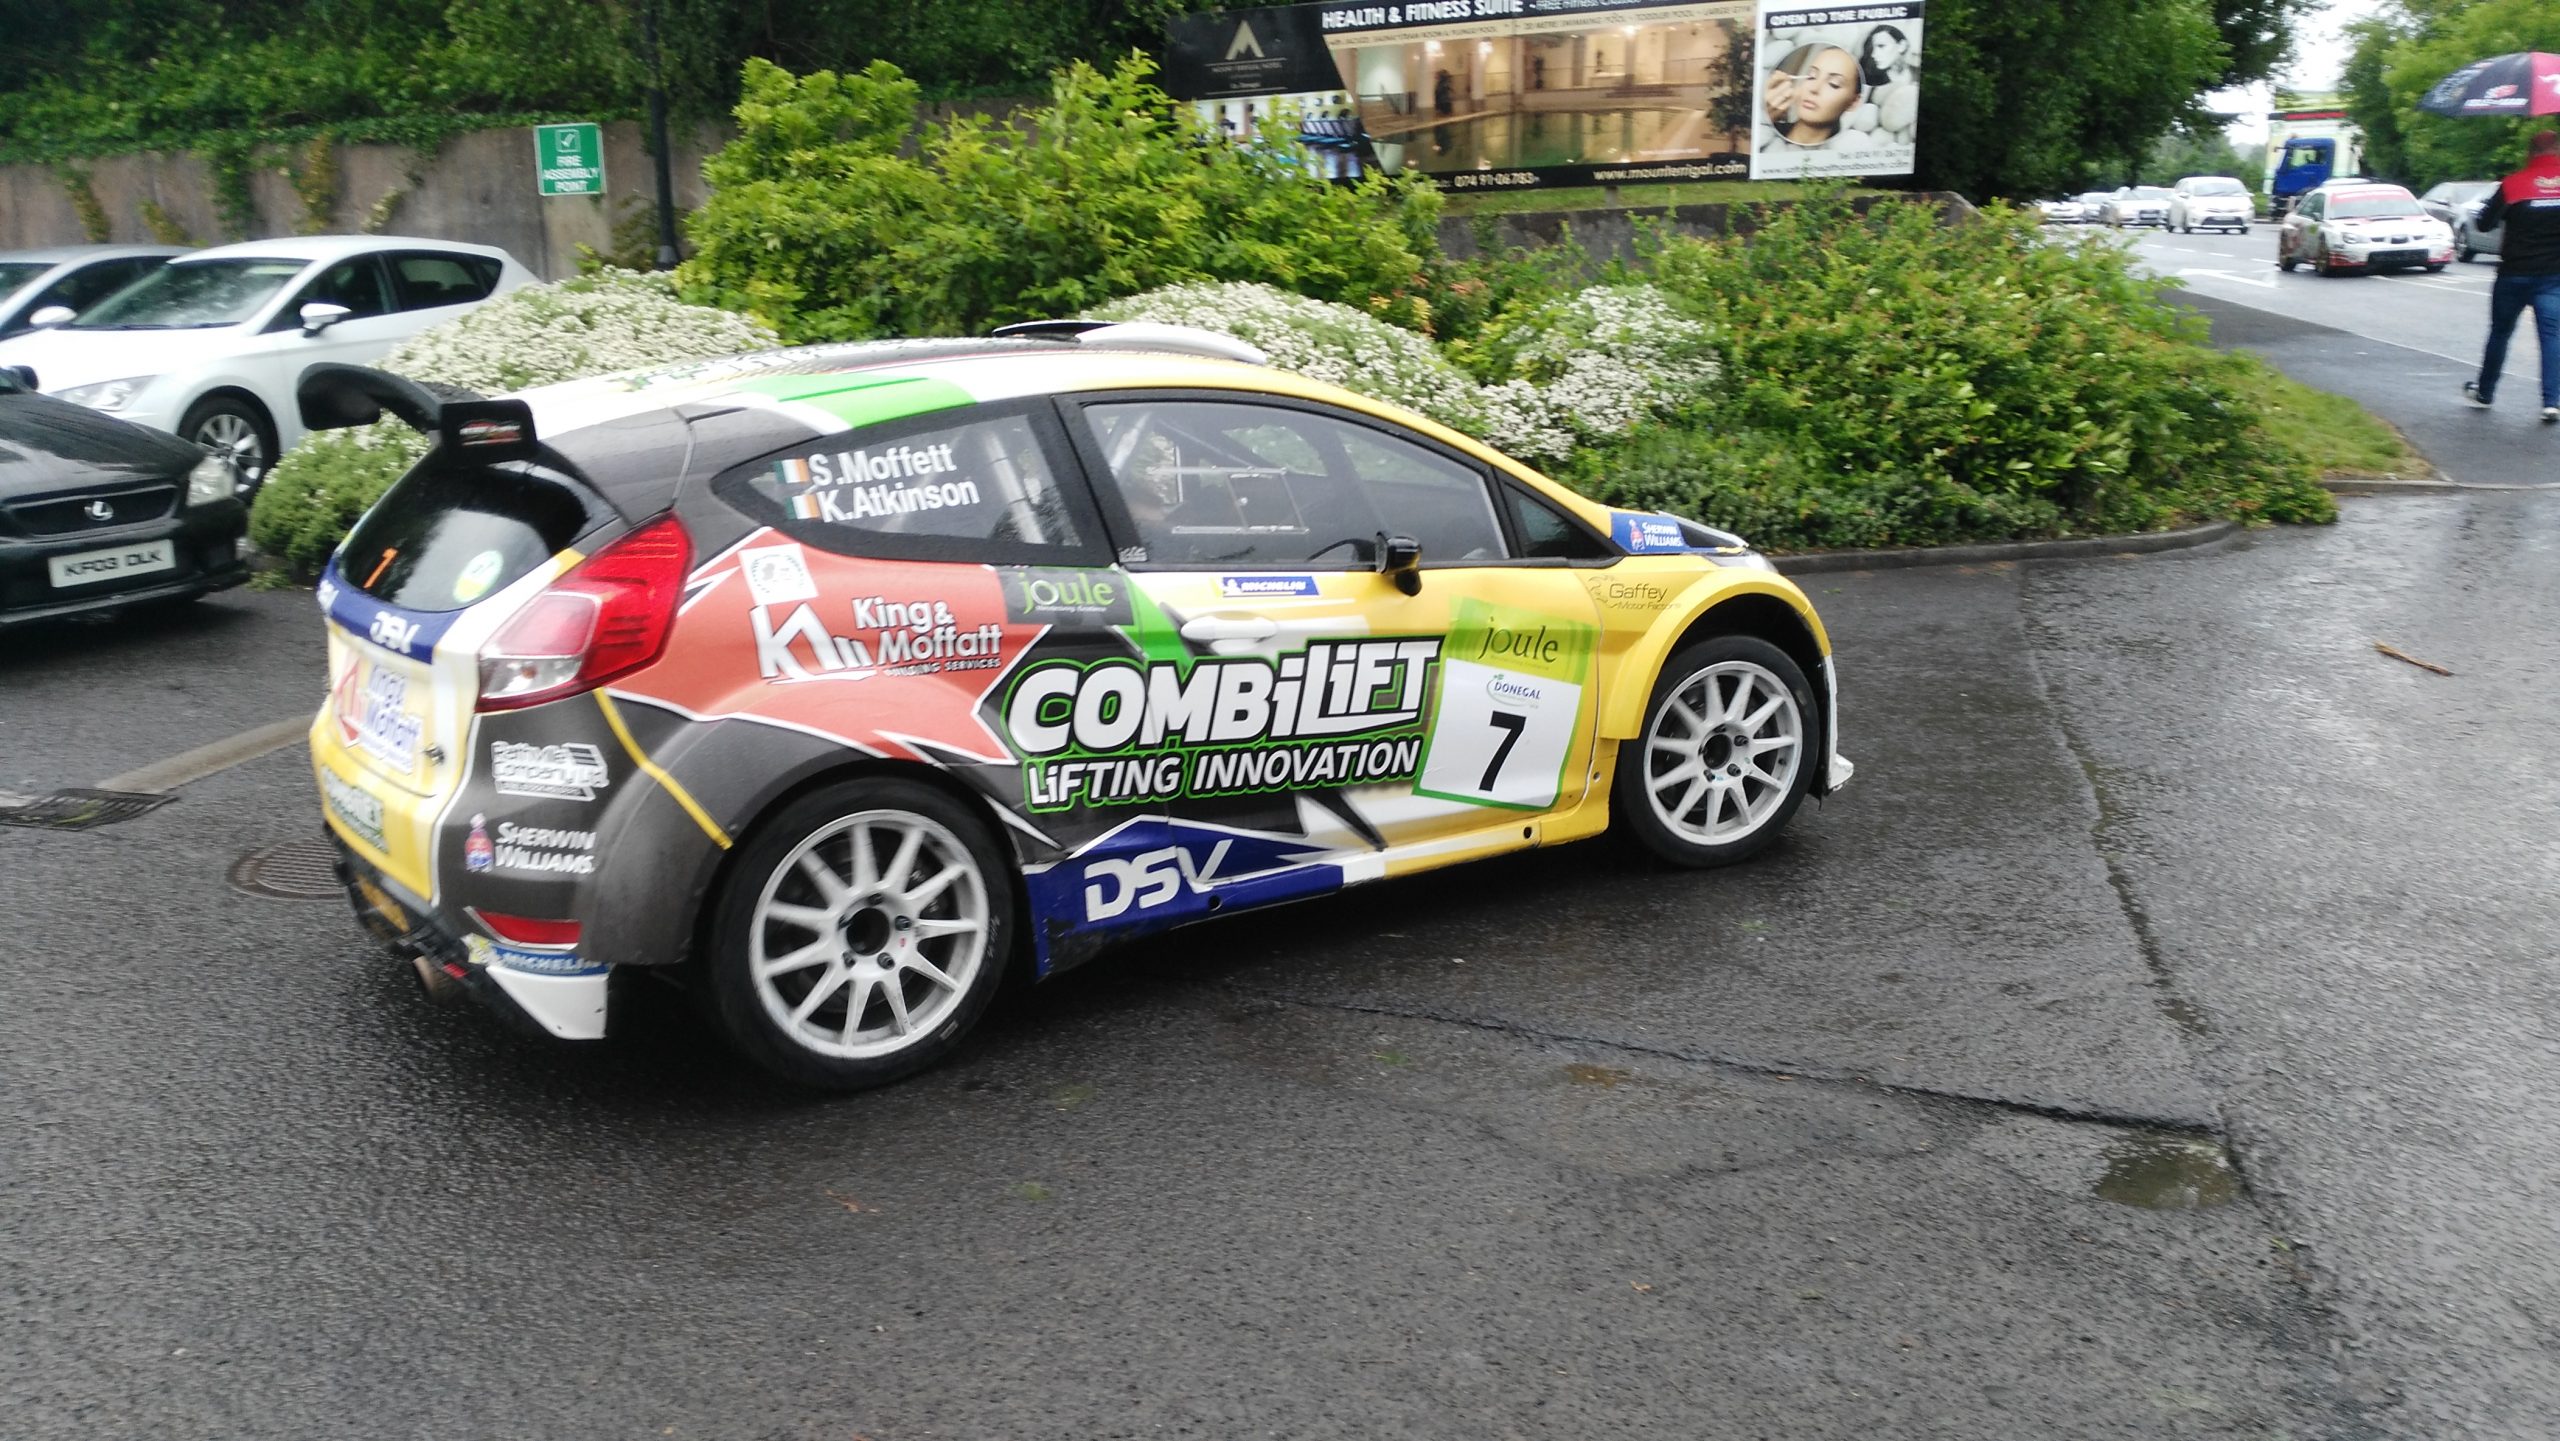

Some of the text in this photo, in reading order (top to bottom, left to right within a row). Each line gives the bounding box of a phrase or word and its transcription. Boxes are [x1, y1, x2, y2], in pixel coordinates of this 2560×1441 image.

[1322, 0, 1524, 29] HEALTH & FITNESS SUITE
[1770, 6, 1908, 26] OPEN TO THE PUBLIC
[1454, 174, 1478, 188] 074
[808, 443, 958, 487] S.Moffett
[816, 479, 981, 523] K.Atkinson
[1018, 571, 1116, 615] joule
[1241, 581, 1306, 592] MICHELIN
[1609, 583, 1669, 602] Gaffey
[876, 624, 1003, 666] Moffatt
[1477, 616, 1559, 664] joule
[944, 657, 1002, 672] SERVICES
[1494, 681, 1541, 700] DONEGAL
[1192, 739, 1422, 791] INNOVATION
[1478, 709, 1528, 792] 7
[496, 821, 598, 850] SHERWIN
[1084, 838, 1234, 922] DSV
